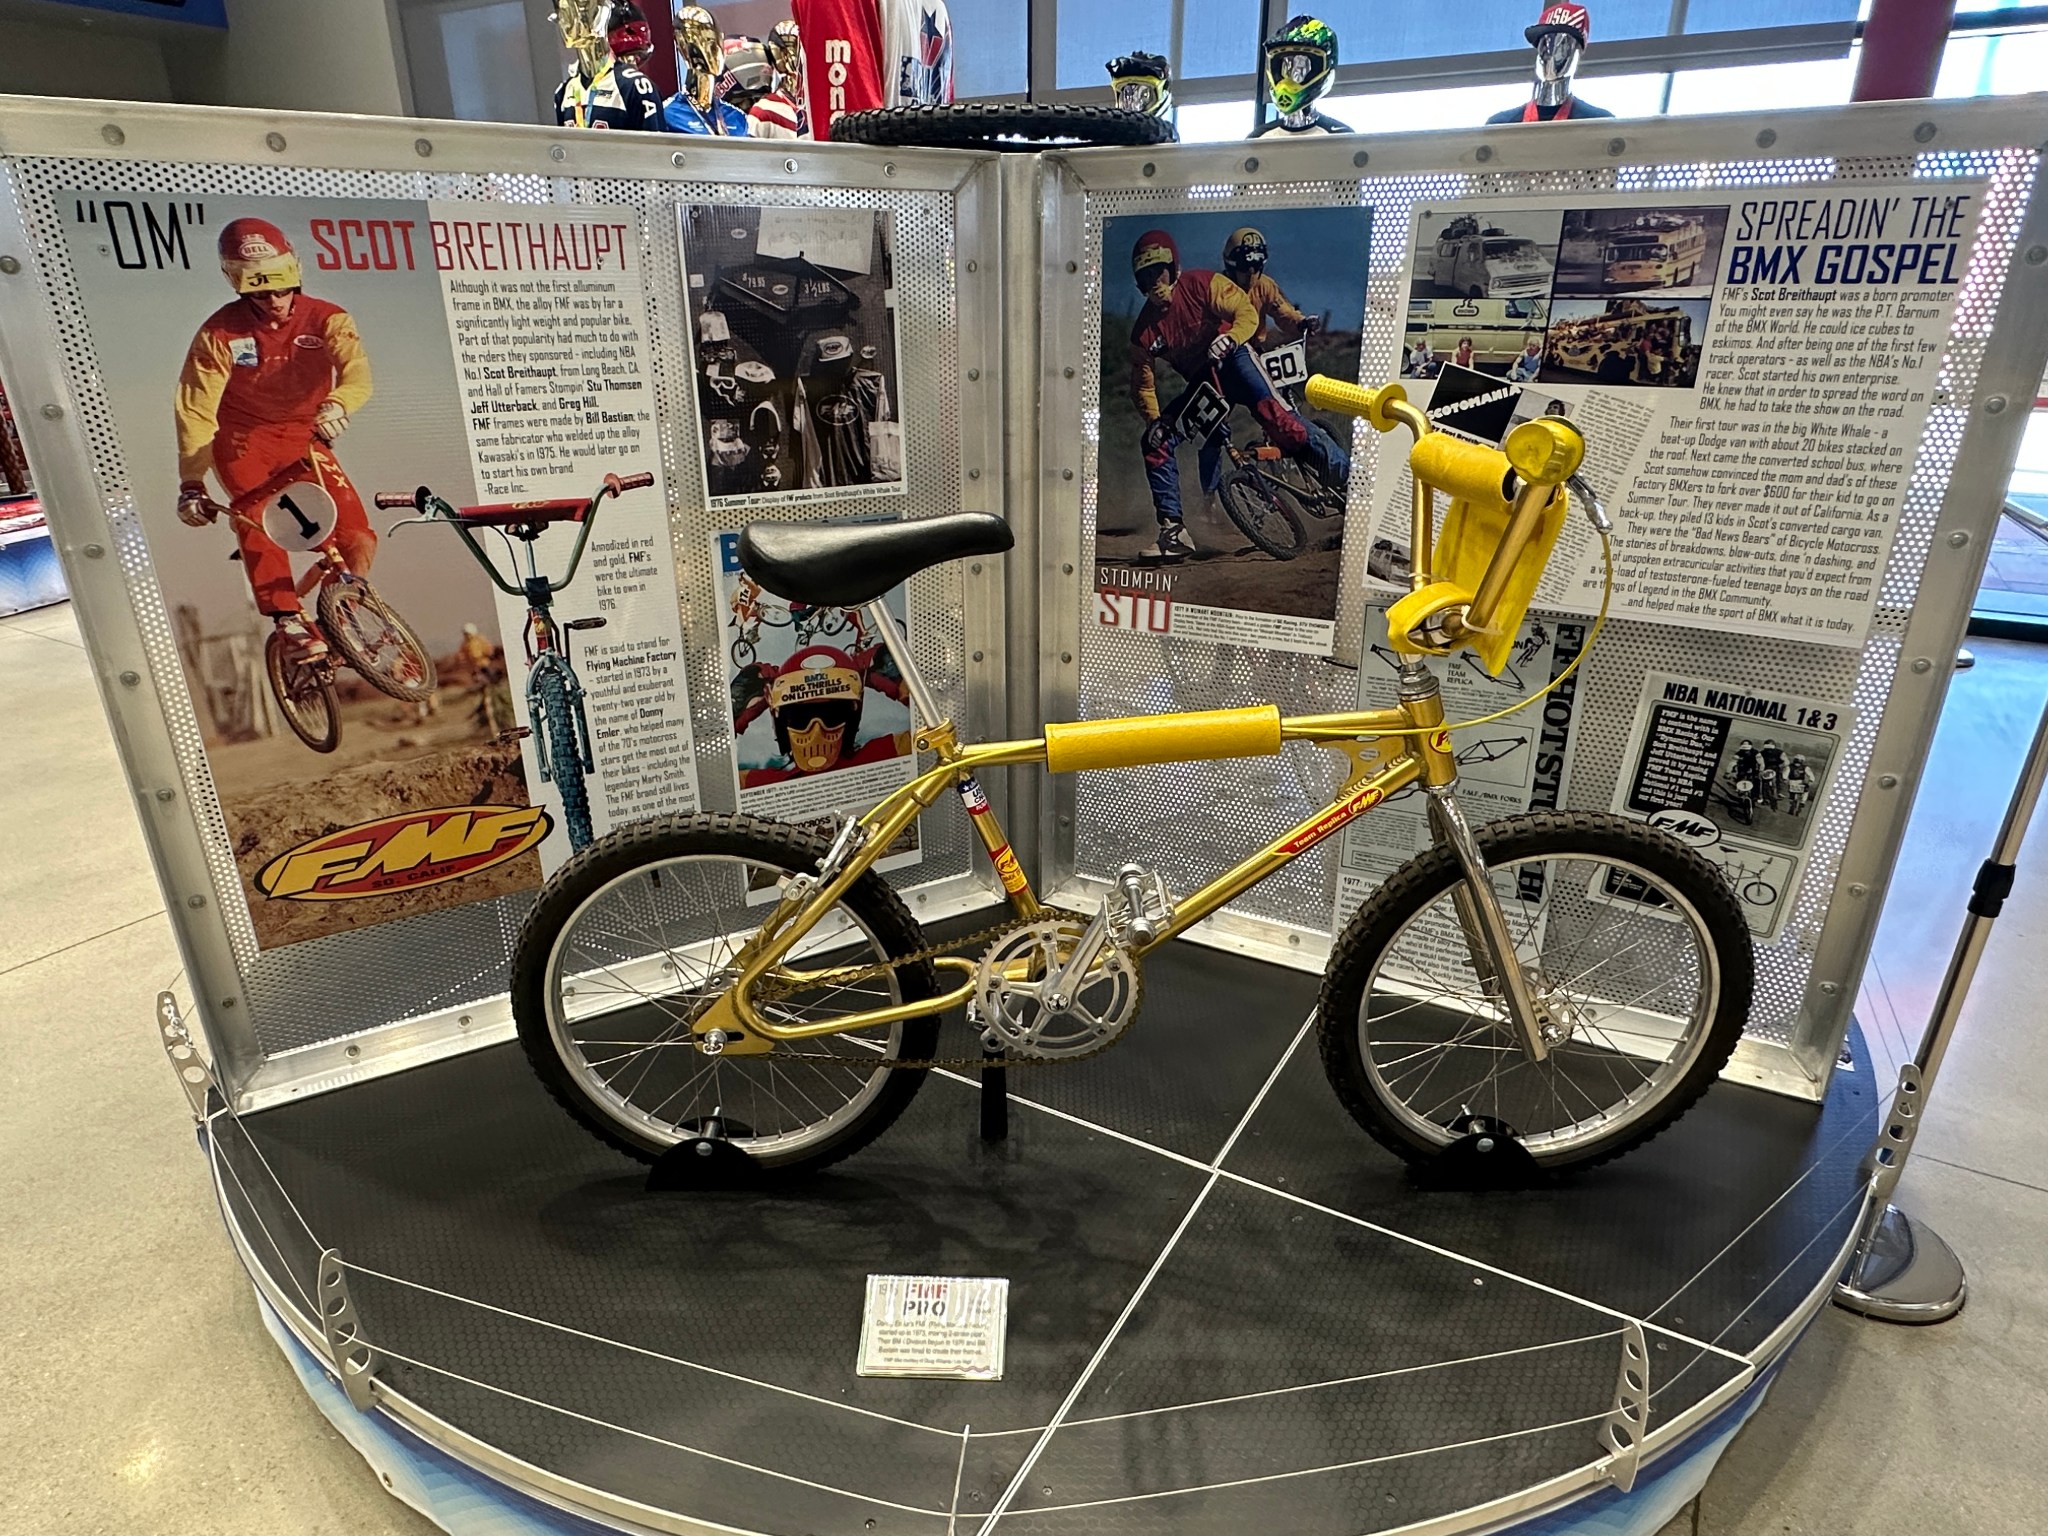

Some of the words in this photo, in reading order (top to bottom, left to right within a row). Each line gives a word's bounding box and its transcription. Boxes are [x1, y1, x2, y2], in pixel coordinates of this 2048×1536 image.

[1736, 197, 1900, 241] SPREADIN'
[1908, 196, 1971, 238] THE
[310, 219, 416, 271] SCOT
[429, 221, 627, 271] BREITHAUPT
[1727, 245, 1808, 285] BMX
[1815, 243, 1960, 285] GOSPEL
[1722, 288, 1748, 300] FMF's
[1751, 288, 1775, 301] Scot
[1778, 289, 1837, 304] Breithaupt
[1840, 292, 1860, 301] was
[1863, 292, 1869, 301] a
[1872, 289, 1897, 301] born
[1720, 304, 1736, 317] You
[1738, 305, 1767, 320] might
[1769, 308, 1793, 317] even
[1795, 308, 1813, 320] say
[1815, 305, 1828, 318] he
[1832, 308, 1852, 318] was
[1855, 306, 1872, 318] the
[1874, 306, 1892, 318] P.T.
[1896, 306, 1939, 318] Barnum
[464, 368, 481, 380] No.1
[483, 367, 505, 379] Scot
[560, 365, 579, 377] from
[581, 364, 599, 379] Long
[1265, 353, 1297, 381] 60
[468, 385, 483, 397] and
[485, 384, 502, 396] Hall
[504, 384, 512, 396] of
[515, 382, 547, 395] Famers
[549, 381, 584, 396] Stompin'
[586, 380, 602, 392] Stu
[604, 378, 642, 391] Thomsen
[470, 402, 488, 414] Jeff
[542, 398, 556, 410] and
[558, 397, 580, 413] Greg
[1425, 384, 1522, 420] SCOTOMANIA
[472, 418, 490, 431] FMF
[493, 416, 524, 429] frames
[526, 418, 547, 428] were
[550, 414, 571, 426] made
[573, 413, 583, 428] by
[585, 412, 599, 424] Bill
[637, 409, 649, 421] the
[277, 494, 320, 540] 1
[631, 539, 638, 548] in
[640, 535, 653, 547] red
[1628, 521, 1647, 537] They
[1650, 526, 1671, 536] were
[1674, 525, 1688, 538] the
[1714, 529, 1739, 542] News
[1776, 534, 1788, 547] of
[1788, 535, 1823, 553] Bicycle
[593, 555, 607, 567] and
[629, 551, 651, 563] FMF's
[1100, 567, 1178, 592] STOMPIN'
[1100, 588, 1171, 633] STU
[1645, 597, 1675, 613] helped
[1676, 601, 1699, 614] make
[1702, 604, 1716, 616] the
[1718, 606, 1743, 622] sport
[1745, 609, 1756, 620] of
[1758, 610, 1778, 623] BMX
[1780, 612, 1802, 626] what
[1805, 615, 1812, 627] it
[1814, 616, 1823, 628] is
[586, 660, 610, 671] Flying
[612, 655, 644, 667] Machine
[646, 651, 676, 663] Factory
[781, 693, 796, 702] ON
[797, 689, 825, 698] LITTLE
[826, 684, 851, 695] BIKES
[790, 684, 806, 693] BIG
[807, 678, 842, 689] THRILLS
[1663, 682, 1699, 704] NBA
[1704, 689, 1788, 722] NATIONAL
[1352, 790, 1379, 813] FMF
[1293, 832, 1317, 848] Team
[1317, 812, 1347, 833] Replica
[1654, 816, 1716, 837] FMF
[266, 804, 547, 899] FMF
